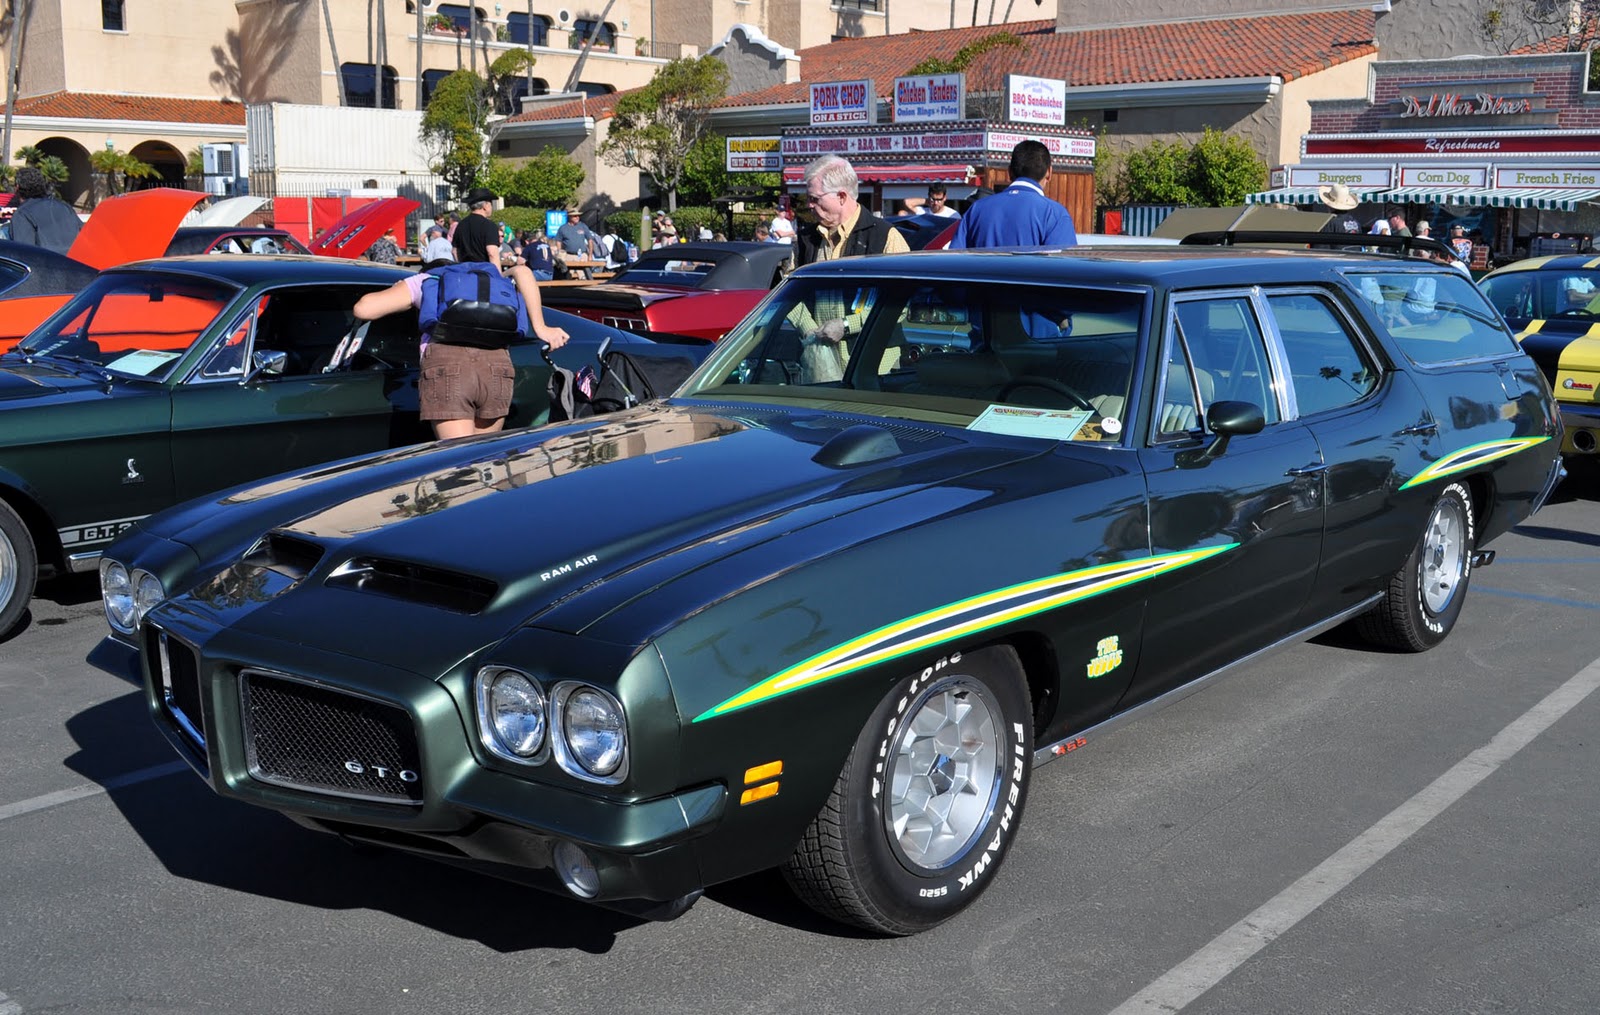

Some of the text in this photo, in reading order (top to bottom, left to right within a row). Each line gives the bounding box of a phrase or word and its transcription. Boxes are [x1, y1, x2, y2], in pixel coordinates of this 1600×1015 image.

[813, 83, 867, 111] PORK CHOP
[898, 78, 958, 105] Chicken Tenders
[1012, 93, 1063, 109] BBQ Sandwiches
[1400, 92, 1532, 119] Del Mar Diner
[813, 112, 867, 122] ON A STICK
[897, 106, 958, 117] Onion Rings Fries
[1031, 109, 1049, 120] Chicken
[818, 138, 849, 151] SANDWICH
[921, 135, 949, 149] CHICKEN
[949, 134, 984, 148] SANDWICH
[1071, 140, 1093, 148] ONION
[1424, 137, 1500, 153] Refreshments
[1318, 172, 1362, 185] Burgers
[1417, 172, 1471, 184] Corn Dog
[1516, 172, 1596, 185] French Fries
[540, 554, 599, 582] RAM AIR
[957, 722, 1025, 892] FIREHAWK
